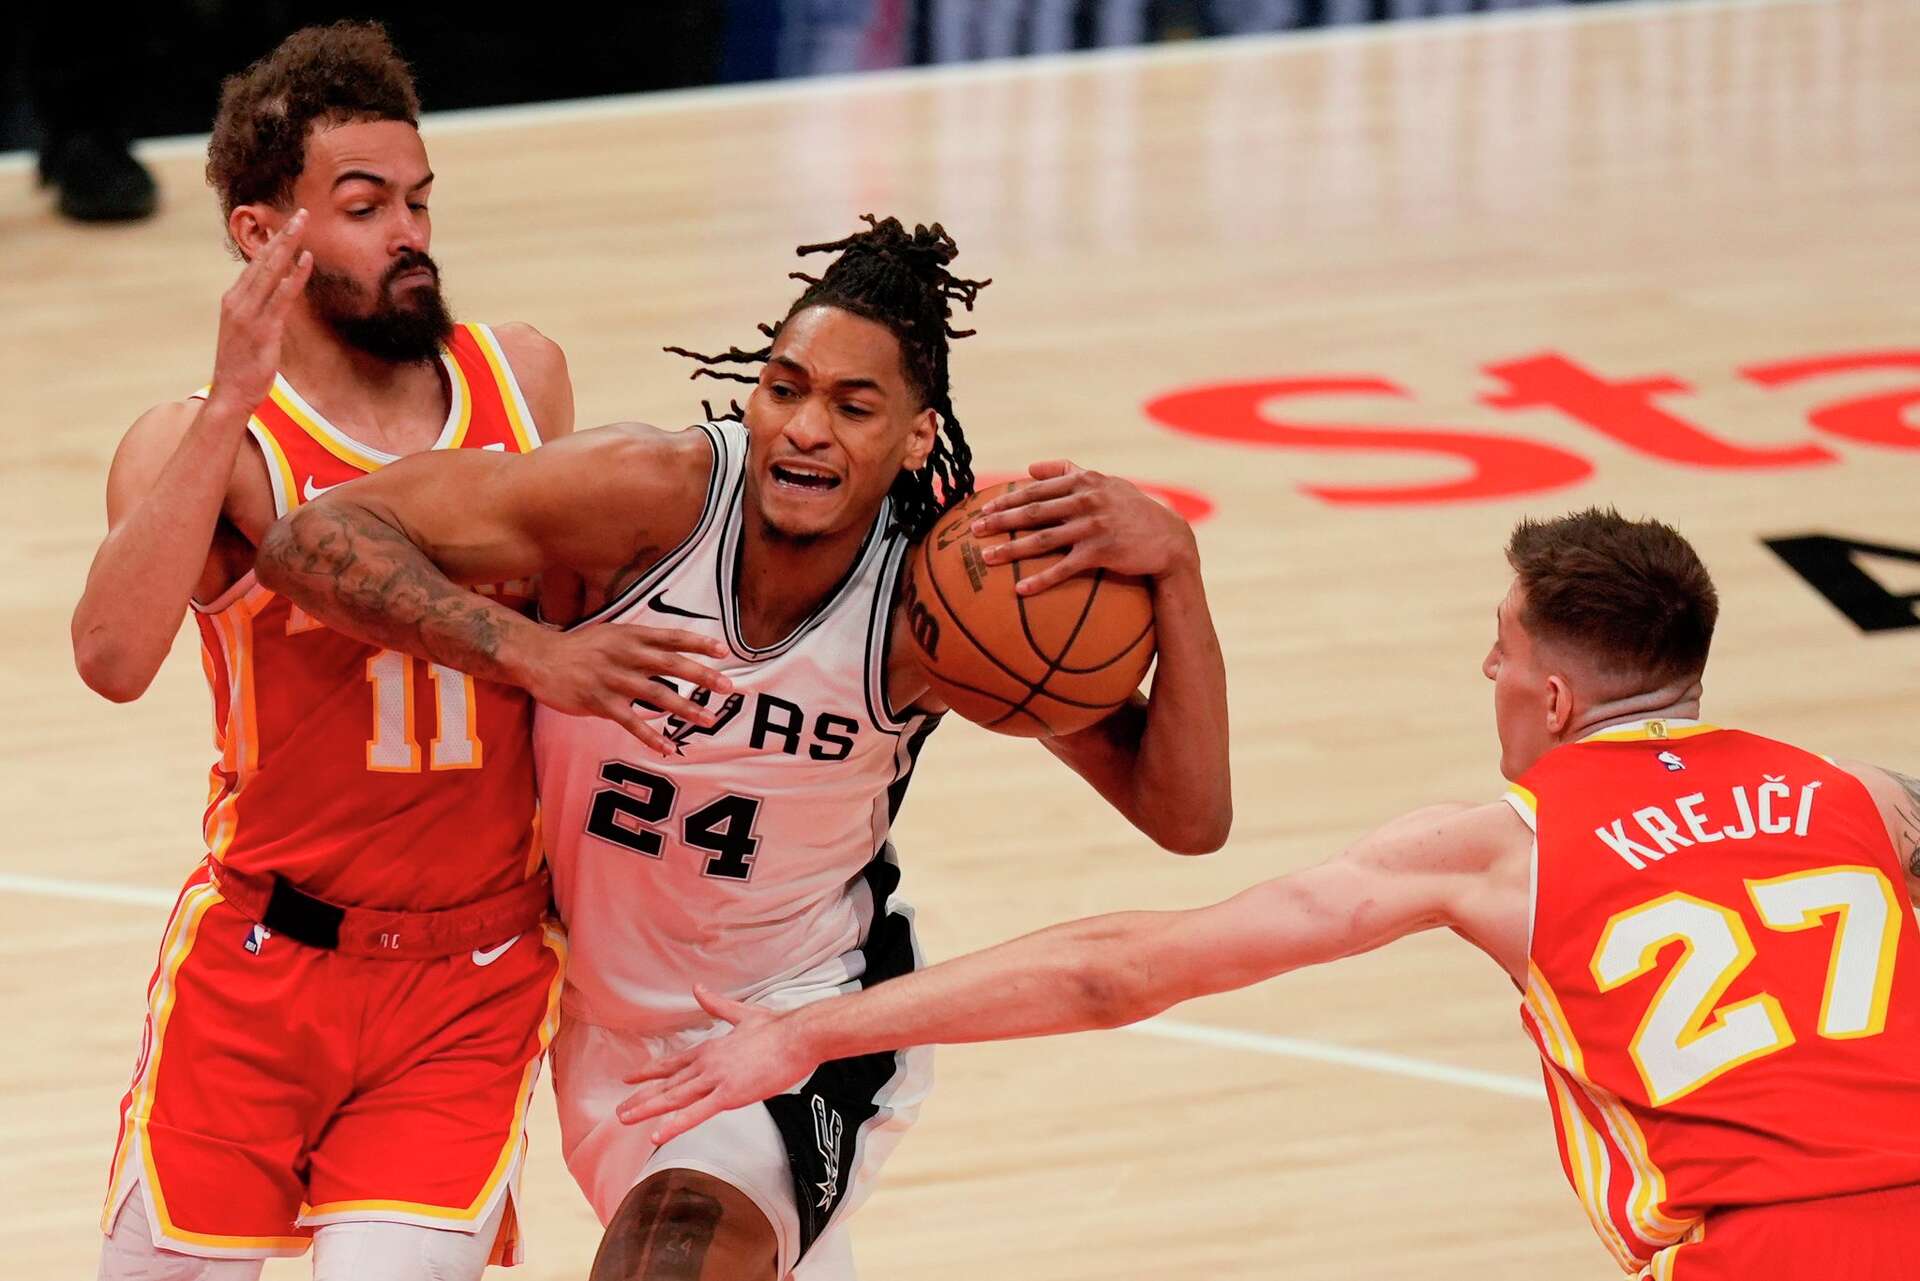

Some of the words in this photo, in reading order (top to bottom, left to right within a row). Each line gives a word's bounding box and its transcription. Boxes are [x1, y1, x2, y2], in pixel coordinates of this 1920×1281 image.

[366, 648, 484, 774] 11
[584, 759, 764, 882] 24
[1594, 774, 1823, 871] KREJČÍ
[1589, 864, 1903, 1108] 27
